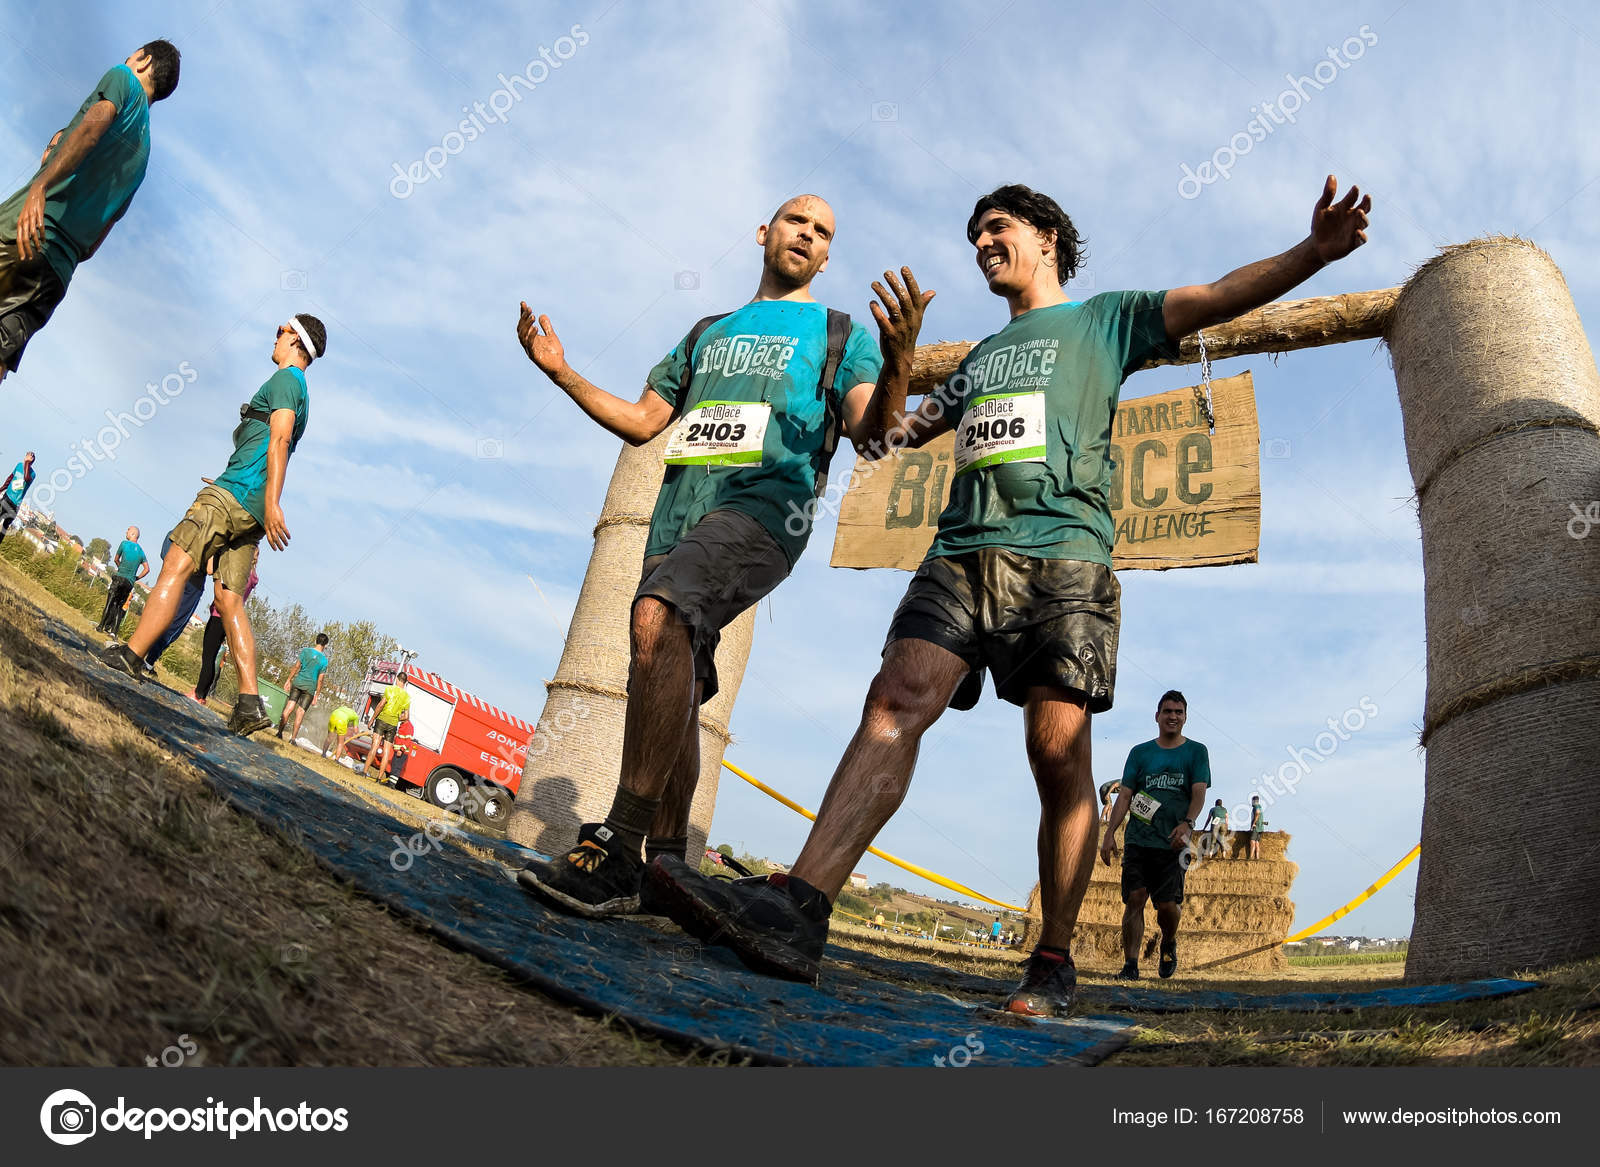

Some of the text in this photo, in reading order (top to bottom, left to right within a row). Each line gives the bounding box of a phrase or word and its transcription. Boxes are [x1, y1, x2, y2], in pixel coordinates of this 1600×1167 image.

[760, 335, 799, 346] ESTARREJA
[1017, 339, 1059, 352] ESTARREJA
[746, 367, 784, 380] CHALLENGE
[1007, 377, 1051, 390] CHALLENGE
[686, 423, 746, 442] 2403
[965, 417, 1025, 448] 2406
[972, 443, 984, 452] JOÃO
[984, 440, 1015, 448] RODRIGUES
[1136, 801, 1151, 813] 2407
